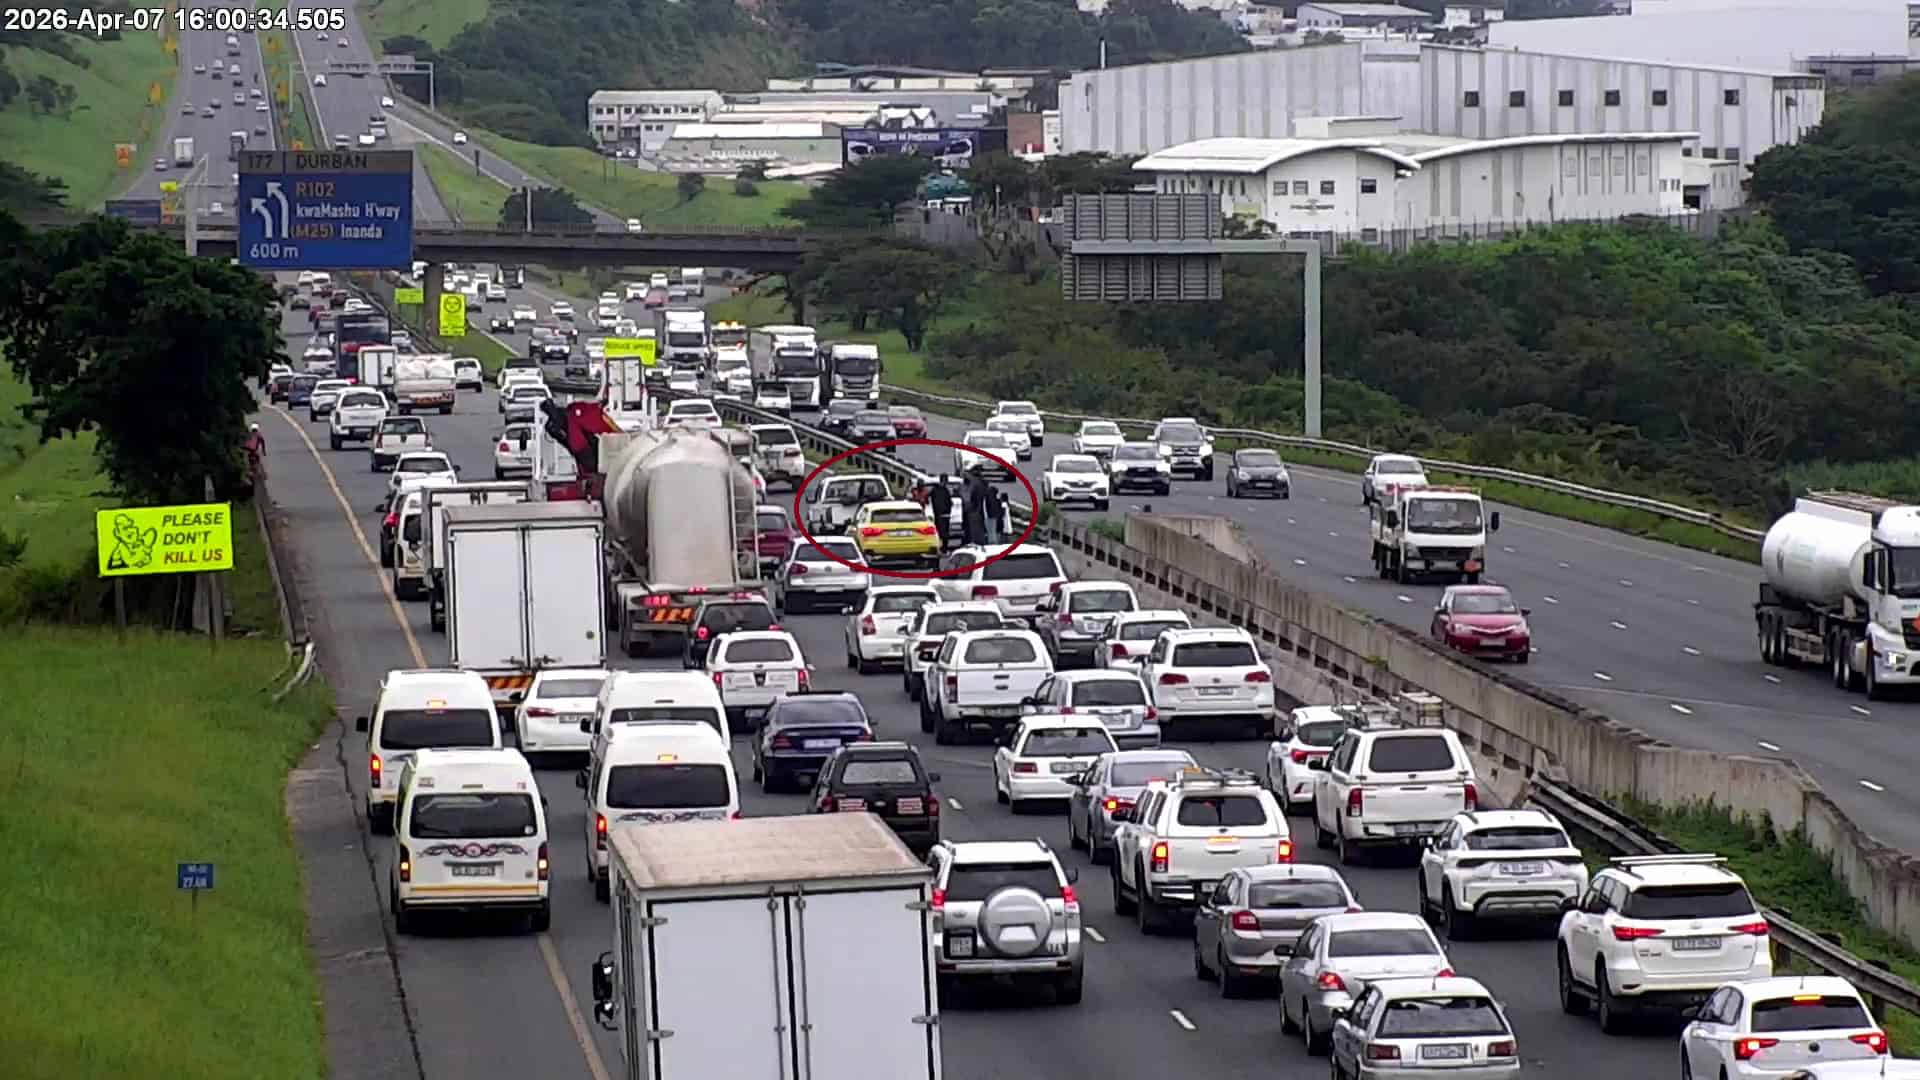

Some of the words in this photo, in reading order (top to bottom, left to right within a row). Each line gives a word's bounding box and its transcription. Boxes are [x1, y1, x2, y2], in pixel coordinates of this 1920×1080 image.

[249, 154, 273, 169] 177
[296, 153, 367, 169] DURBAN
[296, 182, 336, 197] R102
[290, 224, 334, 239] (M25)
[340, 223, 383, 239] Inanda
[250, 243, 280, 259] 600
[283, 246, 299, 258] m
[162, 511, 224, 527] PLEASE
[163, 530, 212, 545] DON'T
[163, 550, 197, 564] KILL
[202, 548, 223, 562] US
